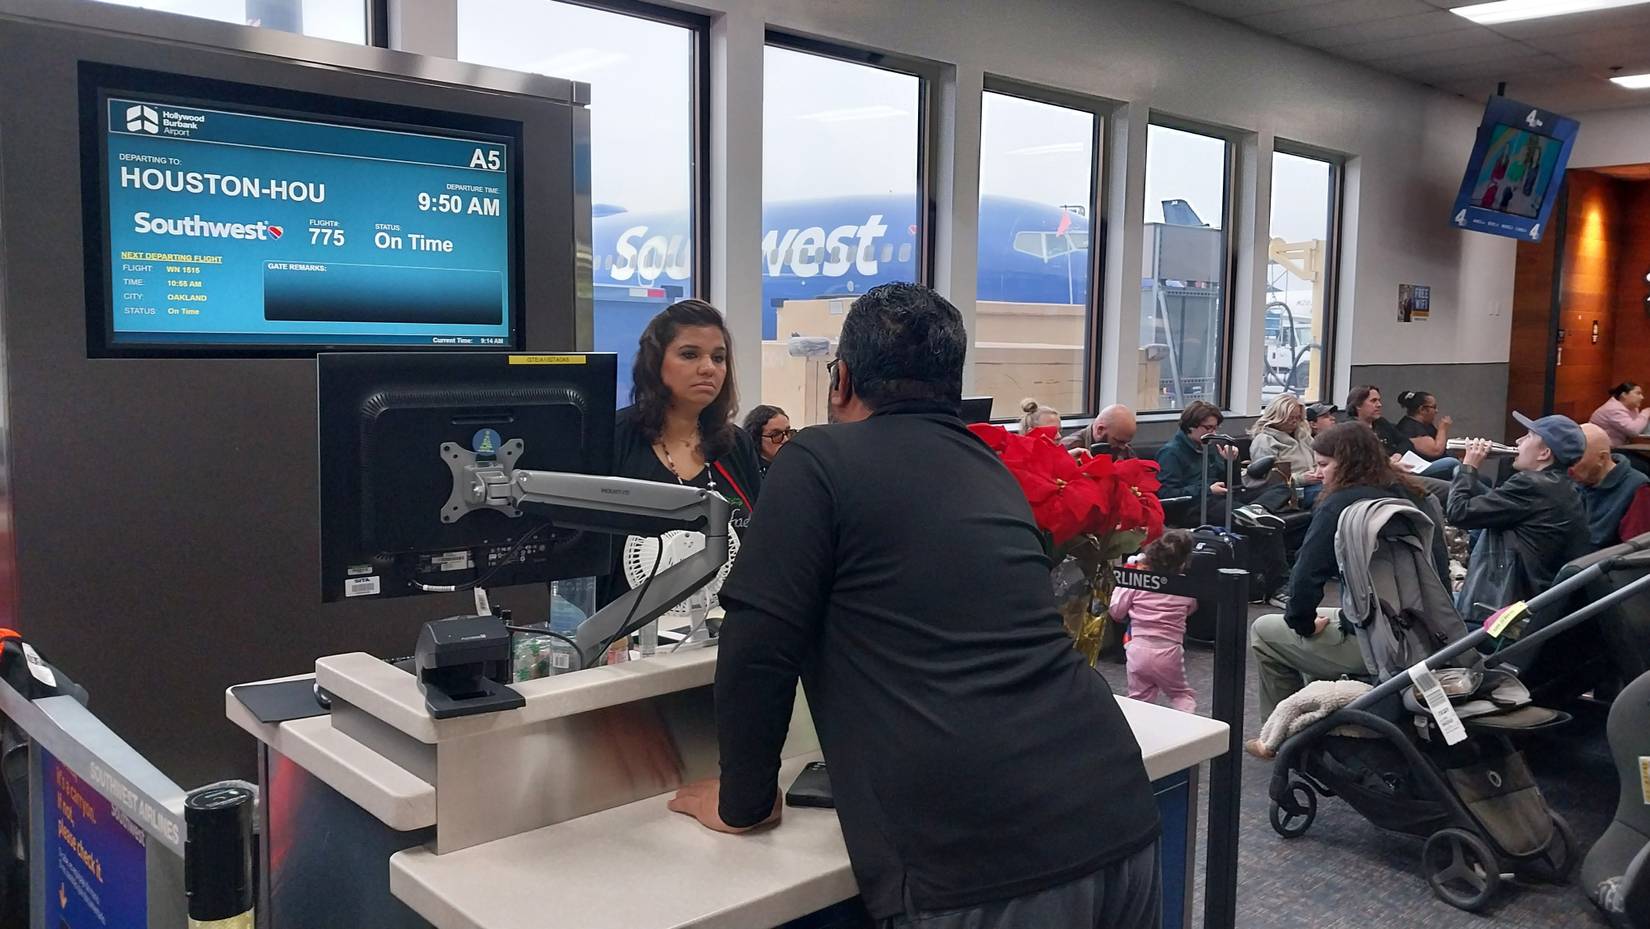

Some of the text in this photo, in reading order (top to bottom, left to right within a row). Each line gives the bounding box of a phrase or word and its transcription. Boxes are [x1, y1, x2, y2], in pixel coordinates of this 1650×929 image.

[163, 111, 204, 122] Hollywood
[163, 119, 198, 129] Burbank
[1526, 109, 1538, 128] 4
[164, 127, 190, 136] Airport
[119, 154, 182, 166] DEPARTING TO:
[470, 148, 500, 170] A5
[121, 166, 325, 203] HOUSTON-HOU
[446, 184, 483, 192] DEPARTURE
[418, 192, 500, 216] 9:50 AM
[134, 212, 267, 240] Southwest
[1455, 208, 1467, 226] 4
[309, 228, 344, 246] 775
[1529, 224, 1540, 240] 4
[375, 232, 453, 252] On Time
[121, 252, 222, 264] NEXT DEPARTING FLIGHT
[122, 264, 152, 272] FLIGHT
[289, 264, 327, 272] REMARKS:
[90, 762, 180, 845] SOUTHWEST AIRLINES
[58, 818, 77, 852] please
[77, 840, 95, 875] check
